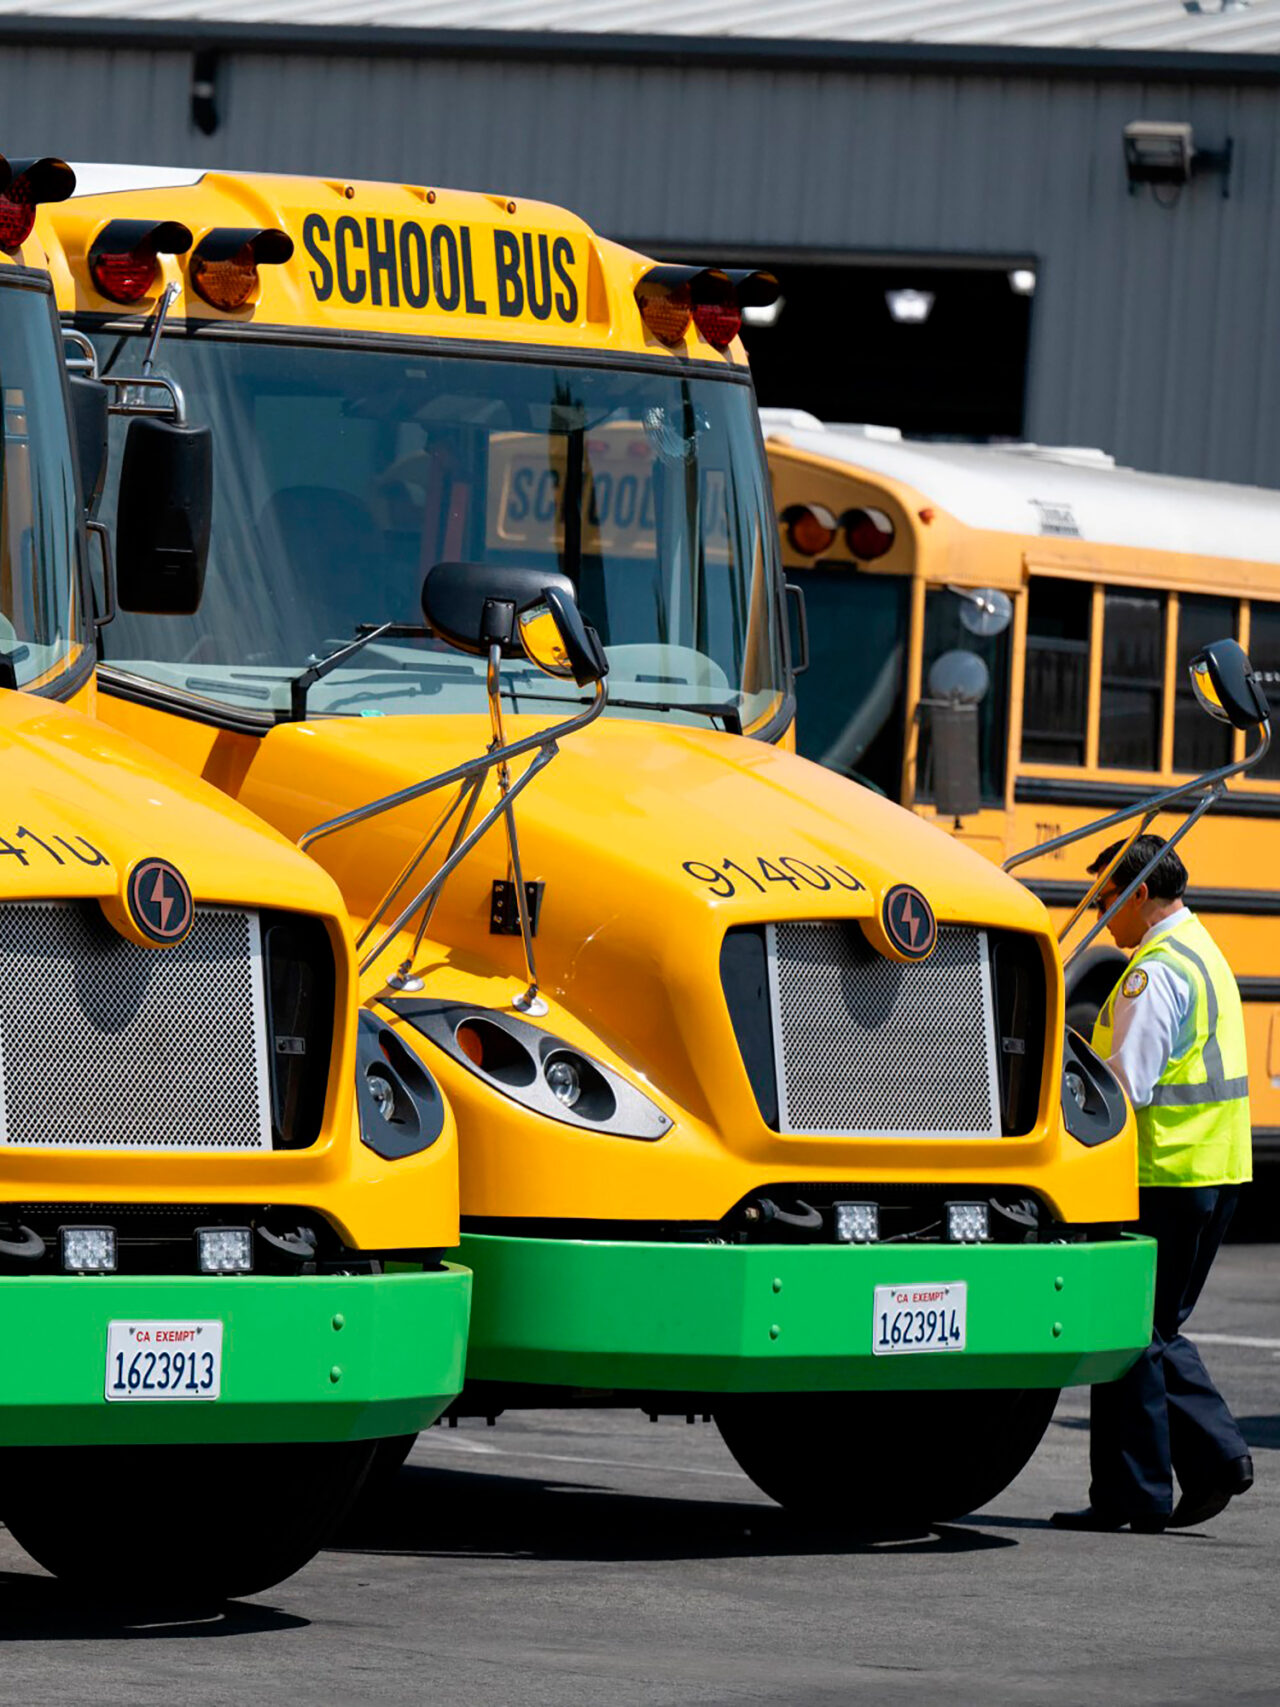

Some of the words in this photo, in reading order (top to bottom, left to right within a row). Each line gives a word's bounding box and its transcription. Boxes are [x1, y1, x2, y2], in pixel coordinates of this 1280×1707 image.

[302, 213, 487, 315] SCHOOL
[493, 229, 578, 323] BUS
[682, 856, 867, 898] 9140u
[896, 1293, 909, 1303] CA
[912, 1291, 945, 1303] EXEMPT
[136, 1331, 151, 1342] CA
[155, 1330, 195, 1342] EXEMPT
[879, 1309, 960, 1345] 1623914
[113, 1351, 214, 1389] 1623913
